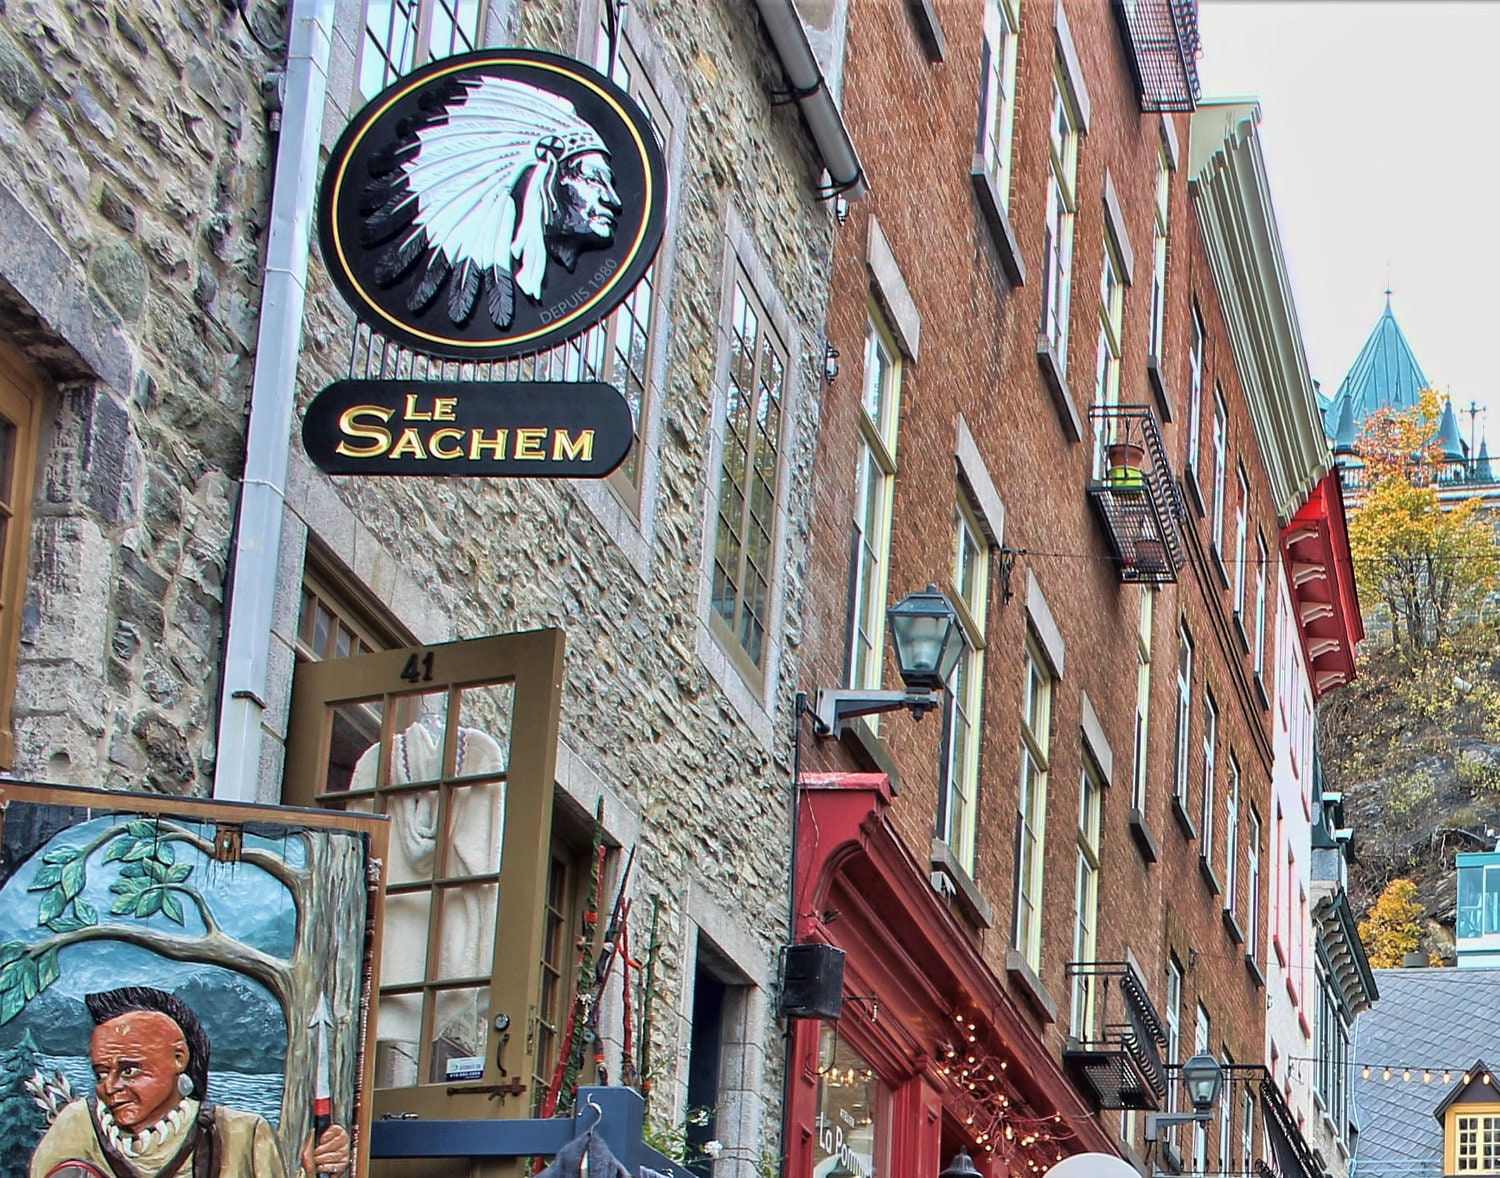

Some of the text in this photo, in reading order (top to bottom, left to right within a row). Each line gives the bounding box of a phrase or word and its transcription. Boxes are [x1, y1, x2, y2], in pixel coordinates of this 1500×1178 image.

[539, 257, 618, 326] DEPUIS 1980
[403, 394, 458, 422] LE
[335, 404, 596, 461] SACHEM
[400, 652, 434, 683] 41
[819, 1111, 832, 1154] La
